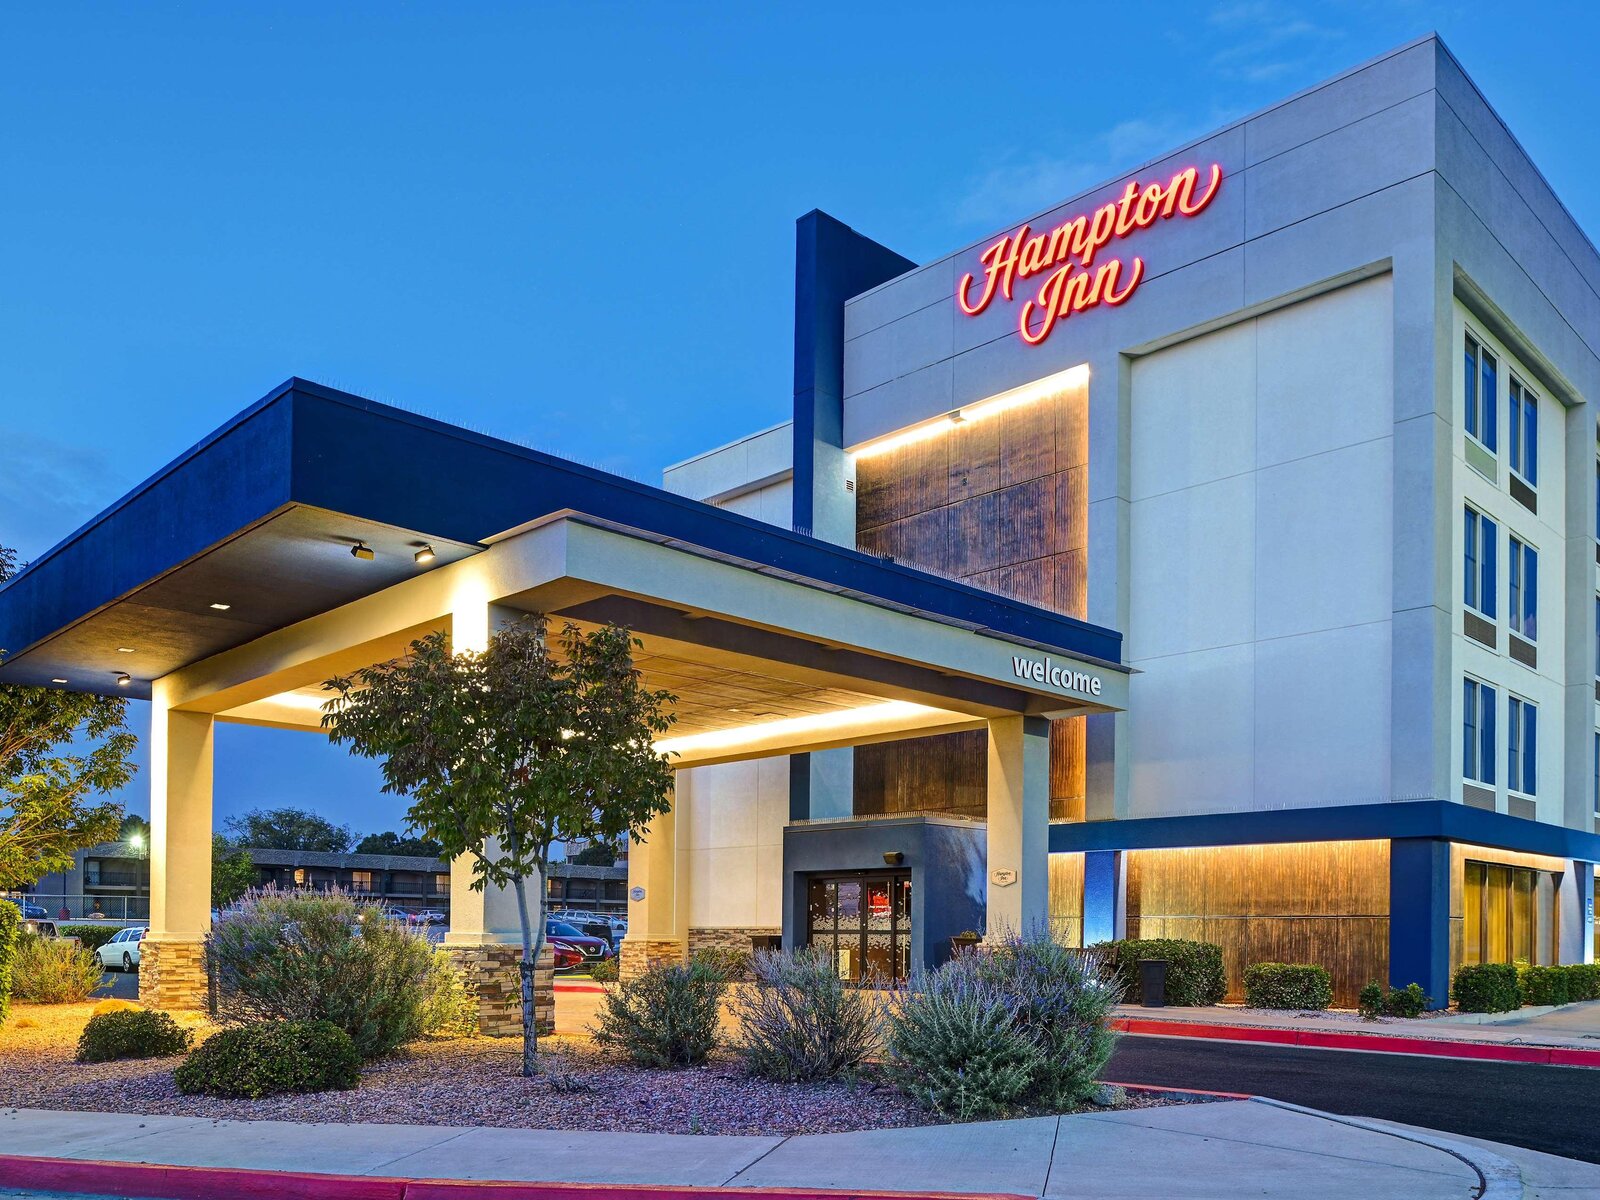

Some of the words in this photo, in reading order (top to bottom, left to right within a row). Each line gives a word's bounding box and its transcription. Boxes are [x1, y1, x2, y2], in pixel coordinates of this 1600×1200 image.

[959, 163, 1222, 316] Hampton
[1020, 257, 1144, 344] Inn
[1012, 656, 1101, 696] welcome
